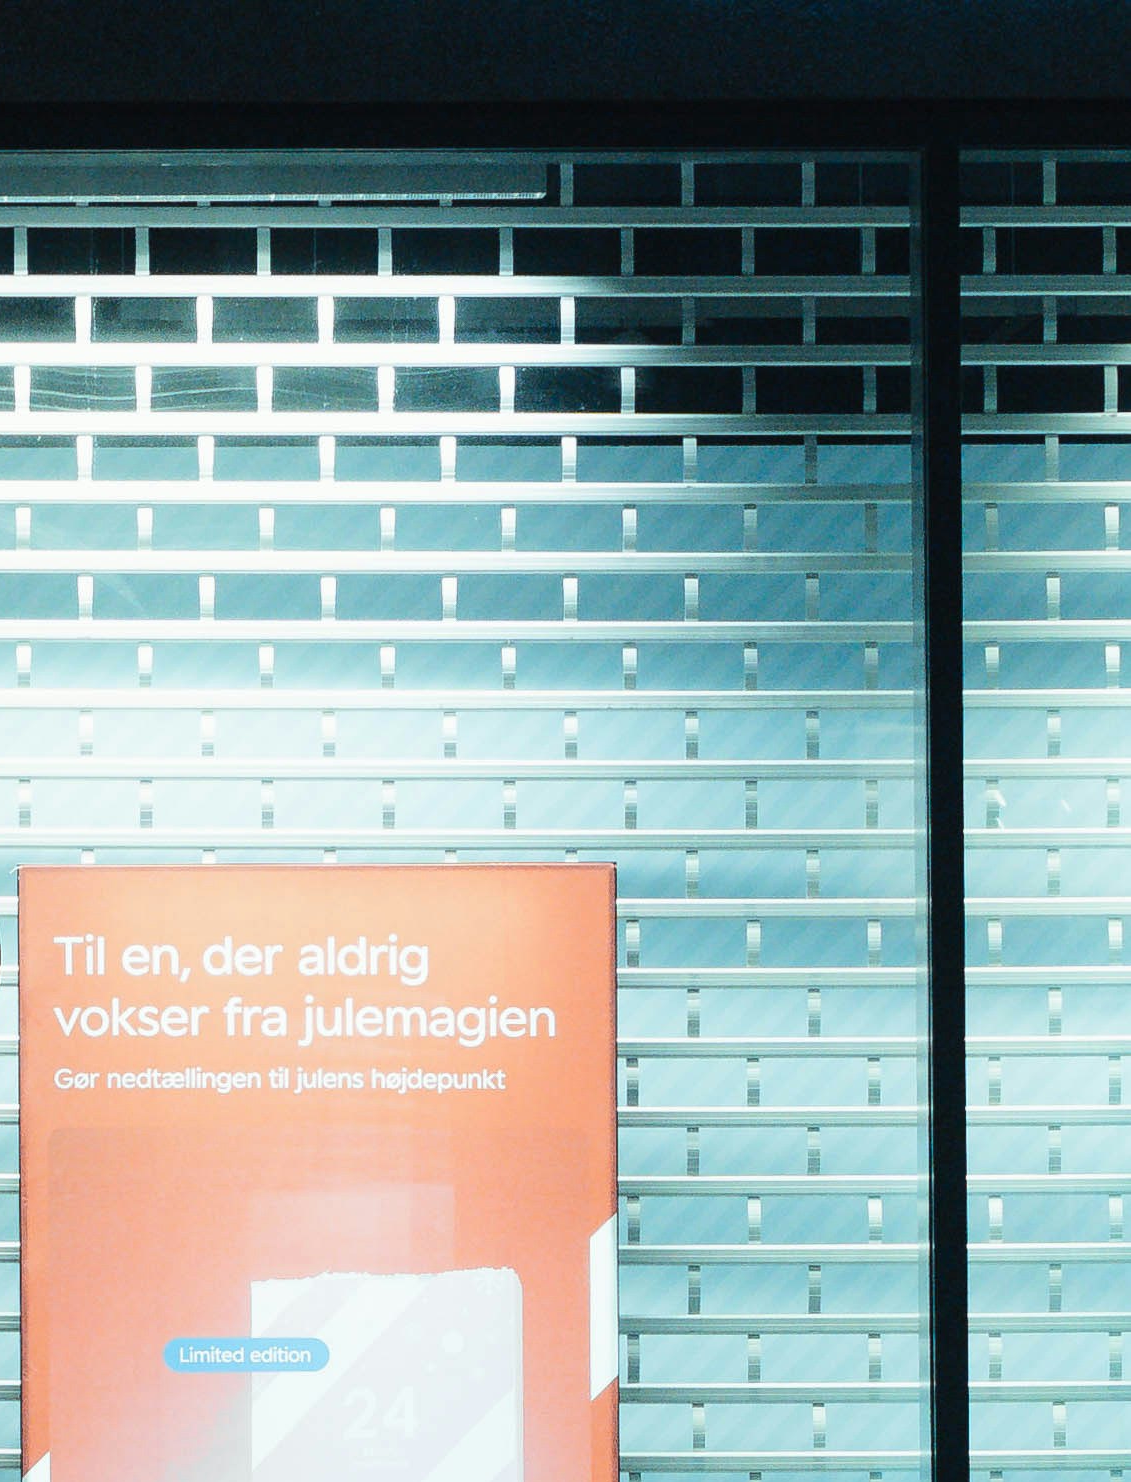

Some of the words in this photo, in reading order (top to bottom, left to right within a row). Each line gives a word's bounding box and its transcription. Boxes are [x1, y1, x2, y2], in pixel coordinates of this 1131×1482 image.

[53, 933, 106, 976] Til
[121, 943, 192, 984] en,
[201, 934, 284, 977] der
[297, 932, 430, 986] aldrig
[53, 996, 211, 1038] vokser
[223, 995, 288, 1038] fra
[297, 993, 557, 1049] julemagien
[53, 1067, 101, 1090] Gør
[106, 1065, 262, 1094] nedtællingen
[267, 1065, 290, 1090] til
[294, 1066, 365, 1094] julens
[370, 1066, 507, 1095] højdepunkt
[179, 1346, 245, 1363] Limited
[249, 1346, 311, 1363] edition
[341, 1385, 421, 1439] 24
